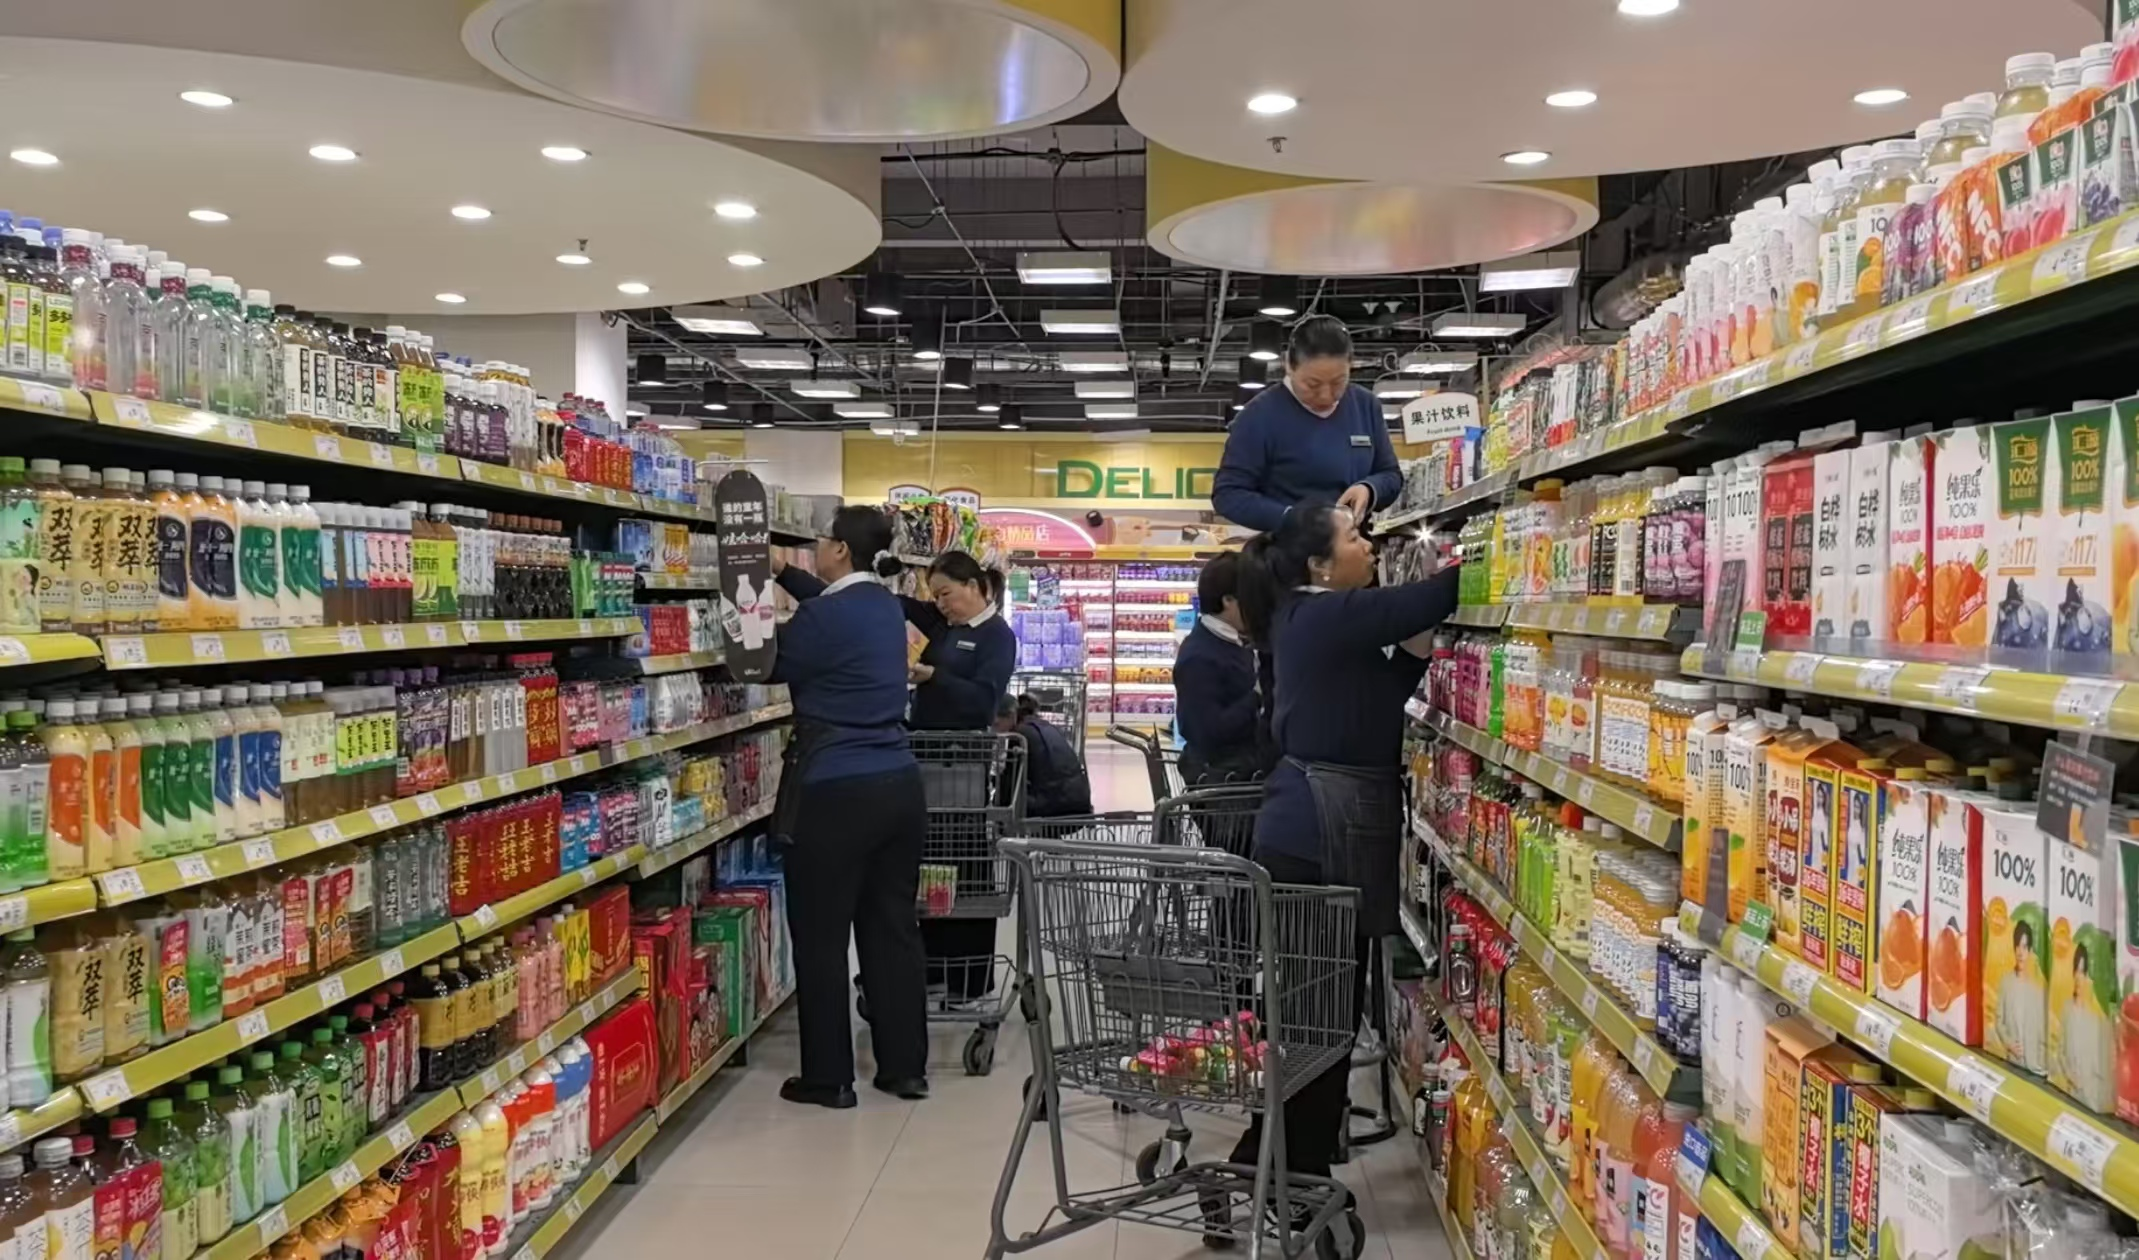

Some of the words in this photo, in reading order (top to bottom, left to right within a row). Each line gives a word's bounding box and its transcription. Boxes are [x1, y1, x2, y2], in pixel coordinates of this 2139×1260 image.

[1410, 404, 1470, 426] 果汁饮料
[1946, 467, 1982, 501] 纯果乐
[2008, 466, 2038, 487] 100%
[2072, 458, 2099, 482] 100%
[1821, 494, 1840, 522] 白桦
[1858, 488, 1879, 518] 白桦
[1949, 502, 1977, 519] 100%
[117, 514, 142, 575] 双萃
[1818, 524, 1838, 551] 树水
[1855, 520, 1876, 548] 树水
[521, 819, 535, 874] 王老吉
[1892, 828, 1924, 864] 纯果乐
[455, 835, 471, 896] 王老吉
[1892, 862, 1918, 882] 100%
[1994, 849, 2036, 888] 100%
[2060, 865, 2095, 908] 100%
[81, 957, 103, 1021] 双萃
[126, 944, 145, 1005] 双萃
